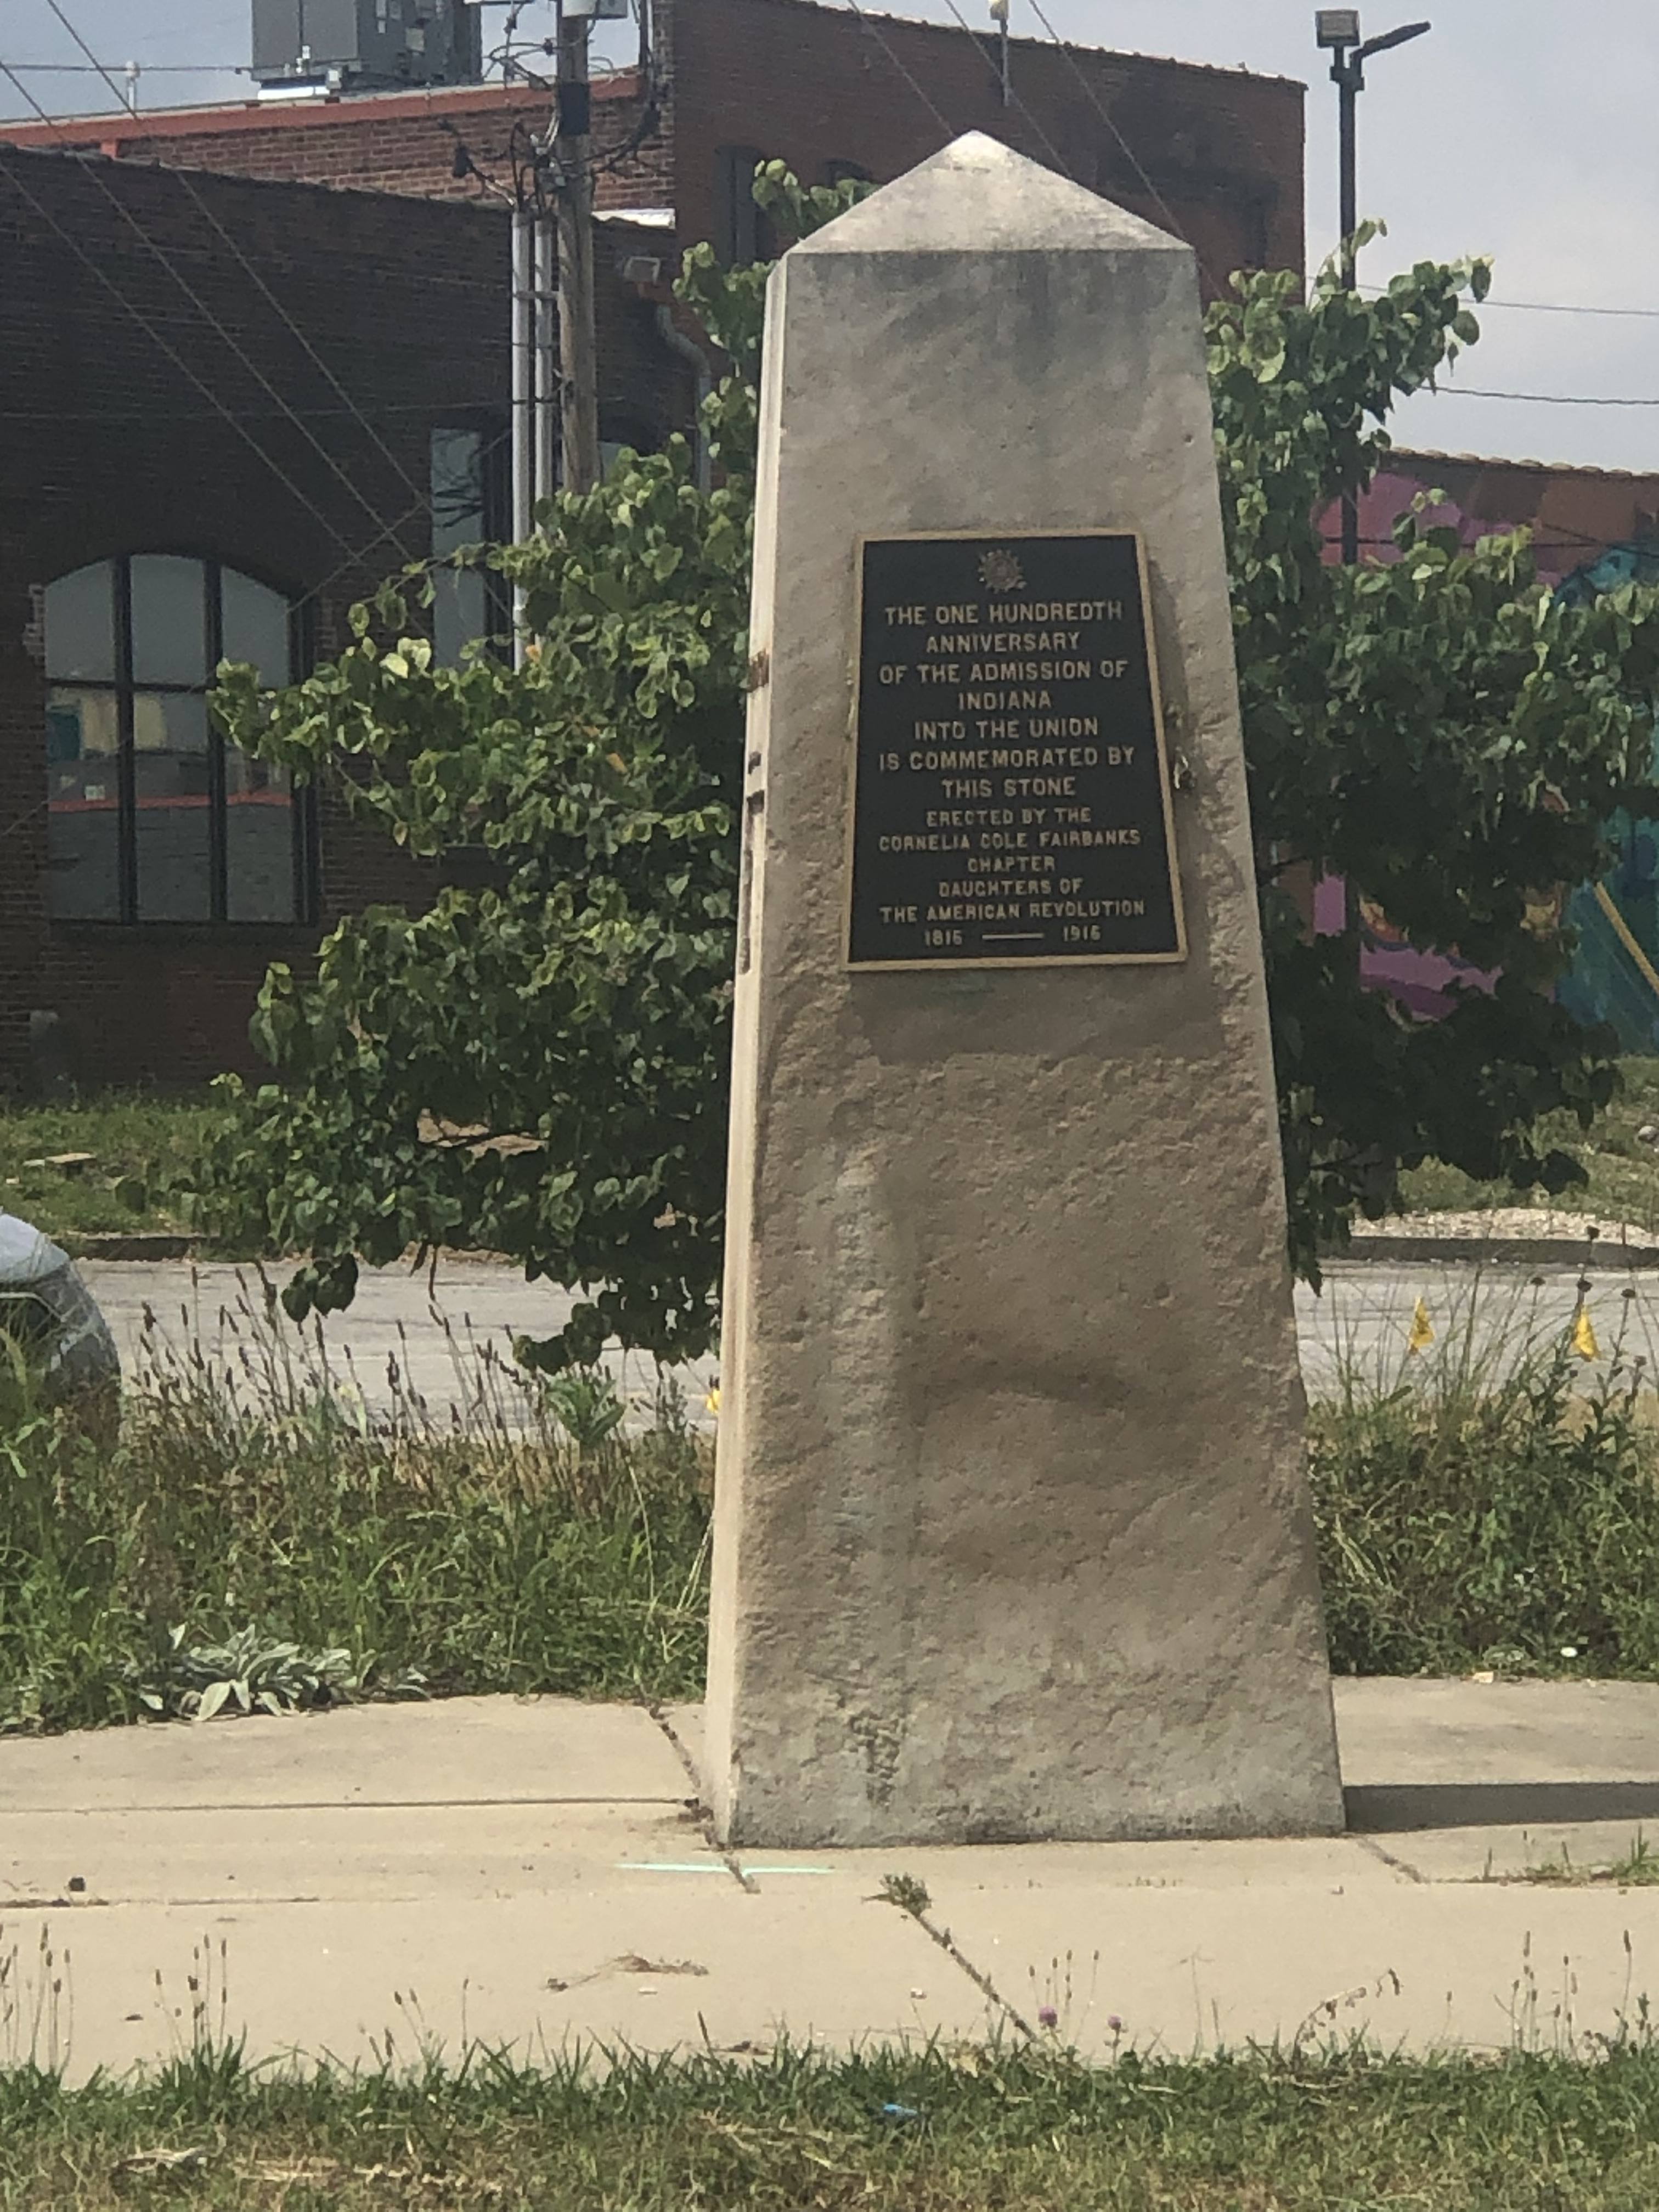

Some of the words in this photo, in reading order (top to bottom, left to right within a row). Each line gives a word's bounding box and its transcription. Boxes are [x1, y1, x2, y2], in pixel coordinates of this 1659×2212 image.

[885, 607, 926, 625] THE
[936, 605, 979, 624] ONE
[989, 601, 1121, 623] HUNDREDTH
[926, 632, 1081, 654] ANNIVERSARY
[880, 665, 907, 684] OF
[917, 664, 960, 683] THE
[970, 661, 1091, 682] ADMISSION
[1100, 661, 1128, 678] OF
[958, 692, 1051, 711] INDIANA
[915, 721, 965, 741] INTO
[976, 720, 1019, 738] THE
[1030, 718, 1098, 737] UNION
[880, 753, 899, 771] IS
[910, 748, 1097, 771] COMMEMORATED
[1108, 747, 1135, 765] BY
[942, 779, 992, 799] THIS
[1004, 777, 1076, 797] STONE
[926, 809, 1013, 827] ERECTED
[1022, 809, 1047, 825] BY
[1054, 808, 1091, 823] THE
[879, 834, 971, 851] CORNELIA
[980, 833, 1027, 849] COLE
[1040, 830, 1141, 847] FAIRBANKS
[968, 856, 1056, 872] CHAPTER
[939, 879, 1051, 897] DAUGHTERS
[1060, 879, 1083, 894] OF
[880, 906, 917, 923] THE
[927, 904, 1019, 921] AMERICAN
[1030, 900, 1144, 918] REVOLUTION
[1063, 926, 1101, 941] 1916
